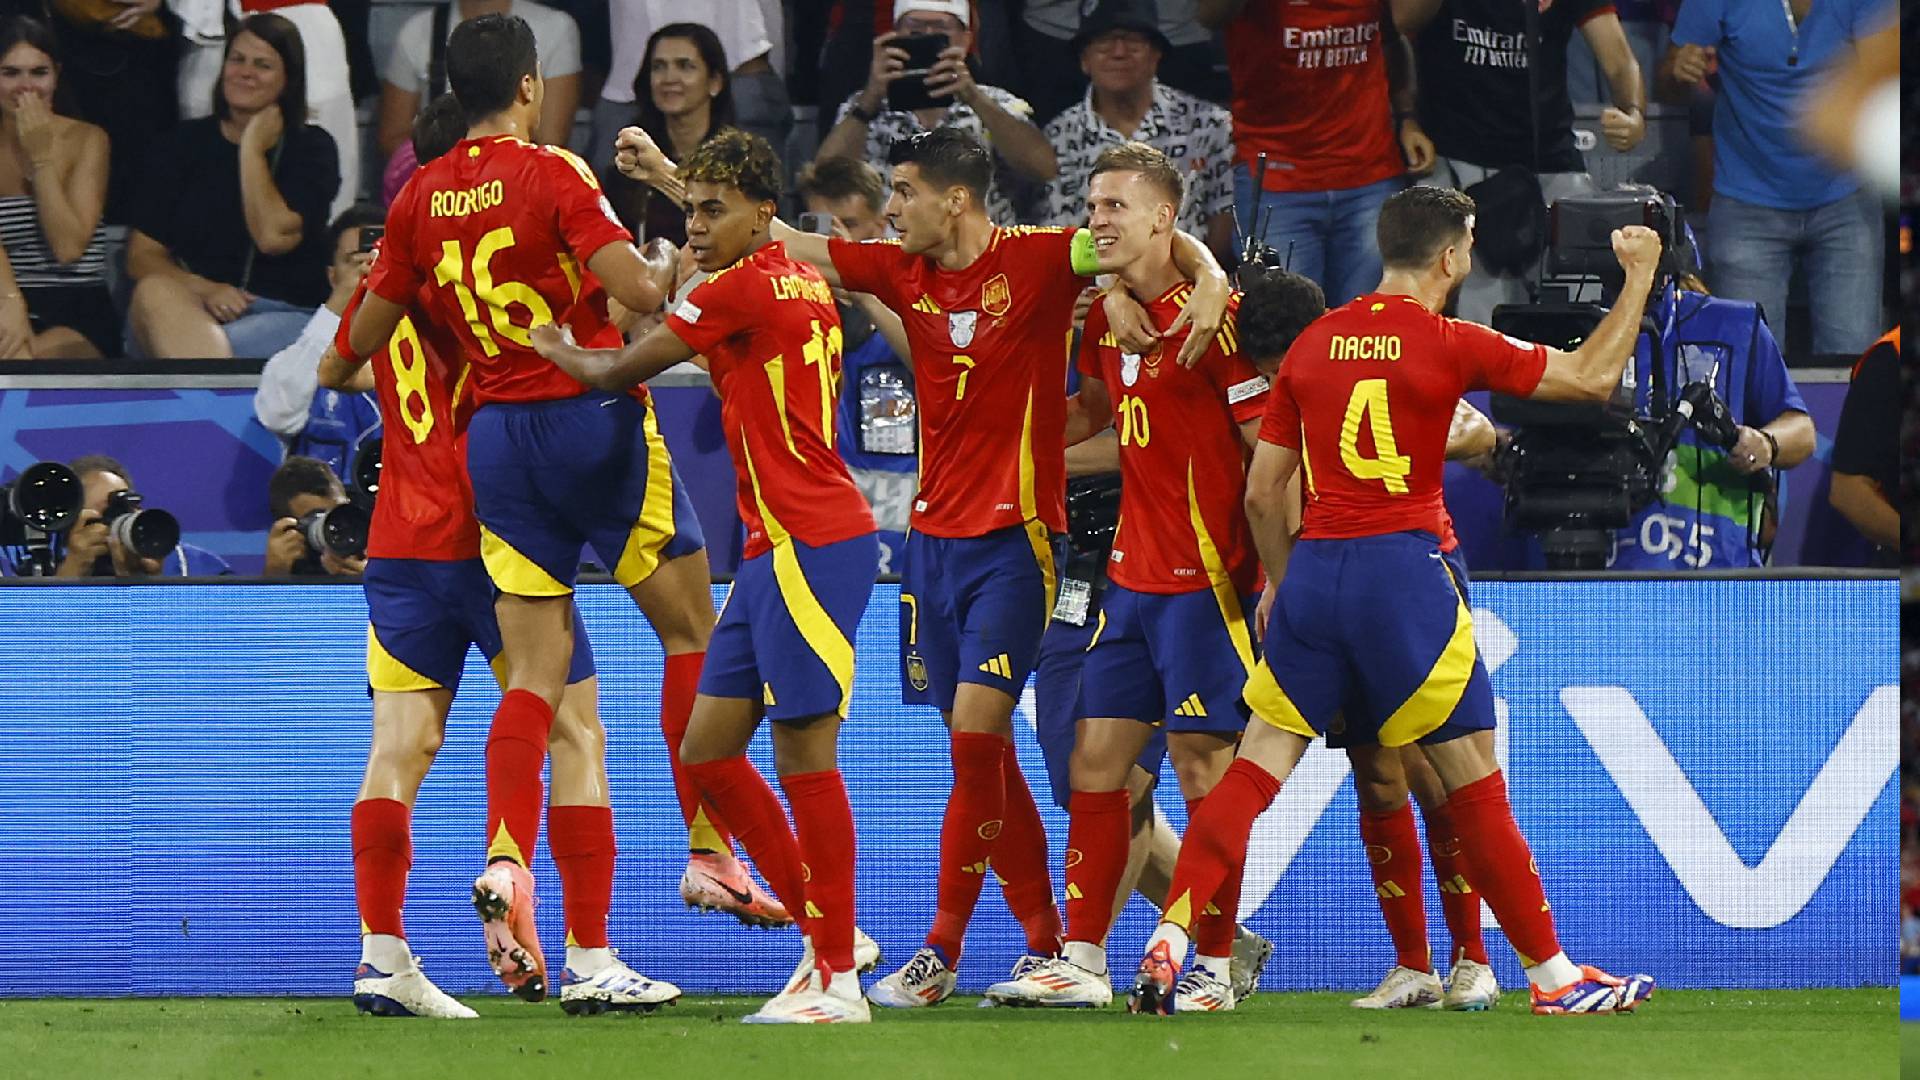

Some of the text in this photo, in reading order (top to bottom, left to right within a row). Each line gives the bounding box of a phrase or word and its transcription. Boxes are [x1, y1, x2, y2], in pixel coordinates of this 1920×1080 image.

[1297, 48, 1323, 69] FLY
[1452, 18, 1543, 50] Emirat
[430, 179, 504, 218] RODRIGO
[433, 226, 553, 358] 16
[1329, 335, 1401, 361] NACHO
[389, 314, 435, 445] 8
[952, 354, 976, 401] 7
[1118, 394, 1150, 448] 10
[1339, 378, 1411, 495] 4
[900, 593, 917, 645] 7
